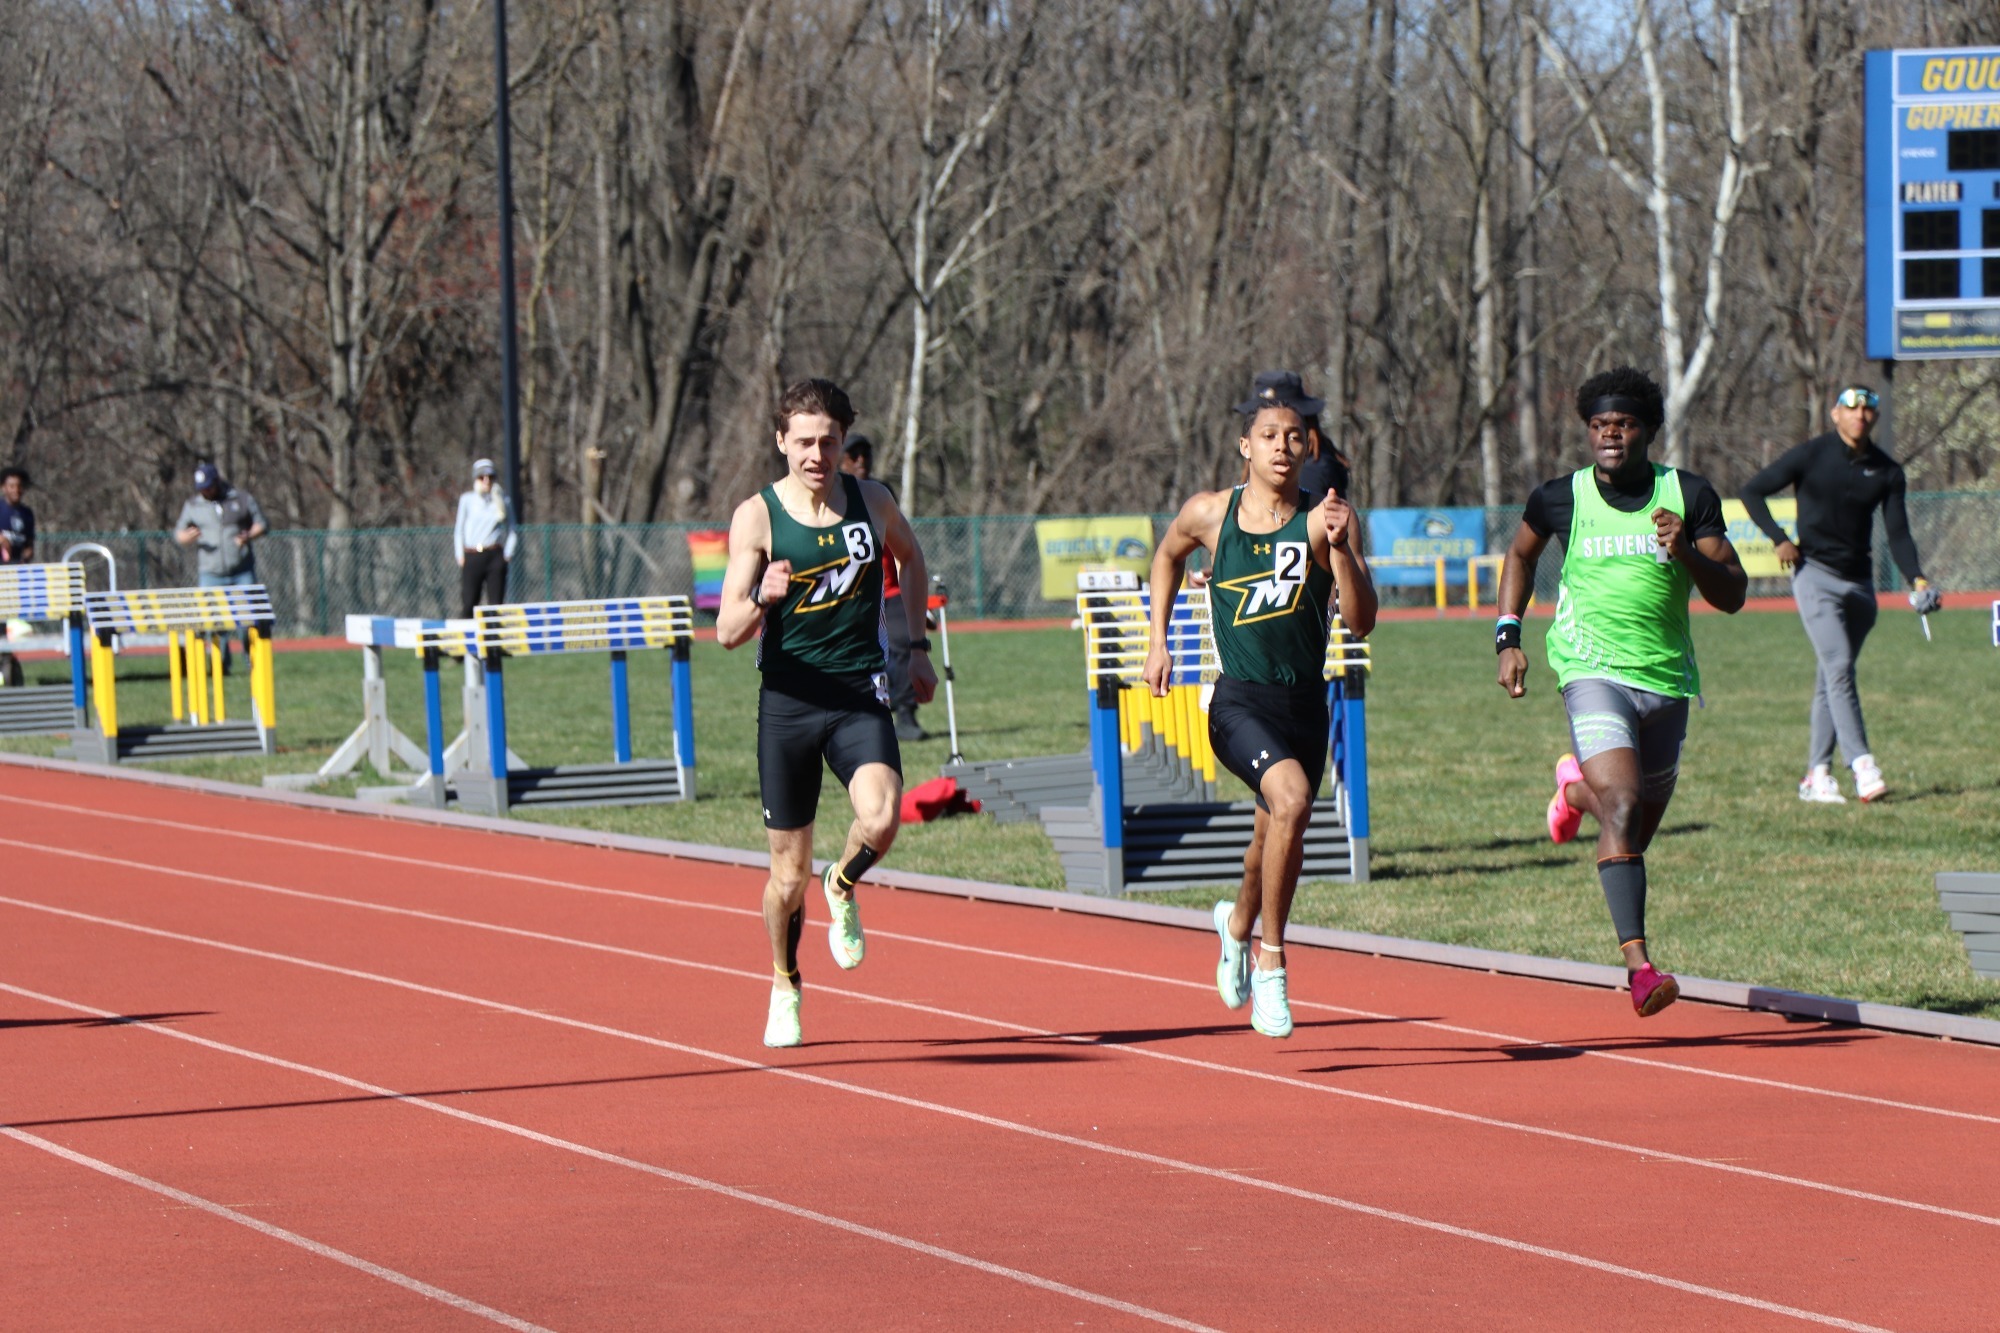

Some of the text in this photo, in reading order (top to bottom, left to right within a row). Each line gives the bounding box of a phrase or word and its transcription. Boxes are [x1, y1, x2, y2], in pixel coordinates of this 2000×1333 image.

[1905, 181, 1958, 203] PLAYER
[849, 527, 871, 561] 3
[1583, 533, 1658, 558] STEVENS
[1279, 546, 1301, 581] 2
[1246, 579, 1294, 615] M
